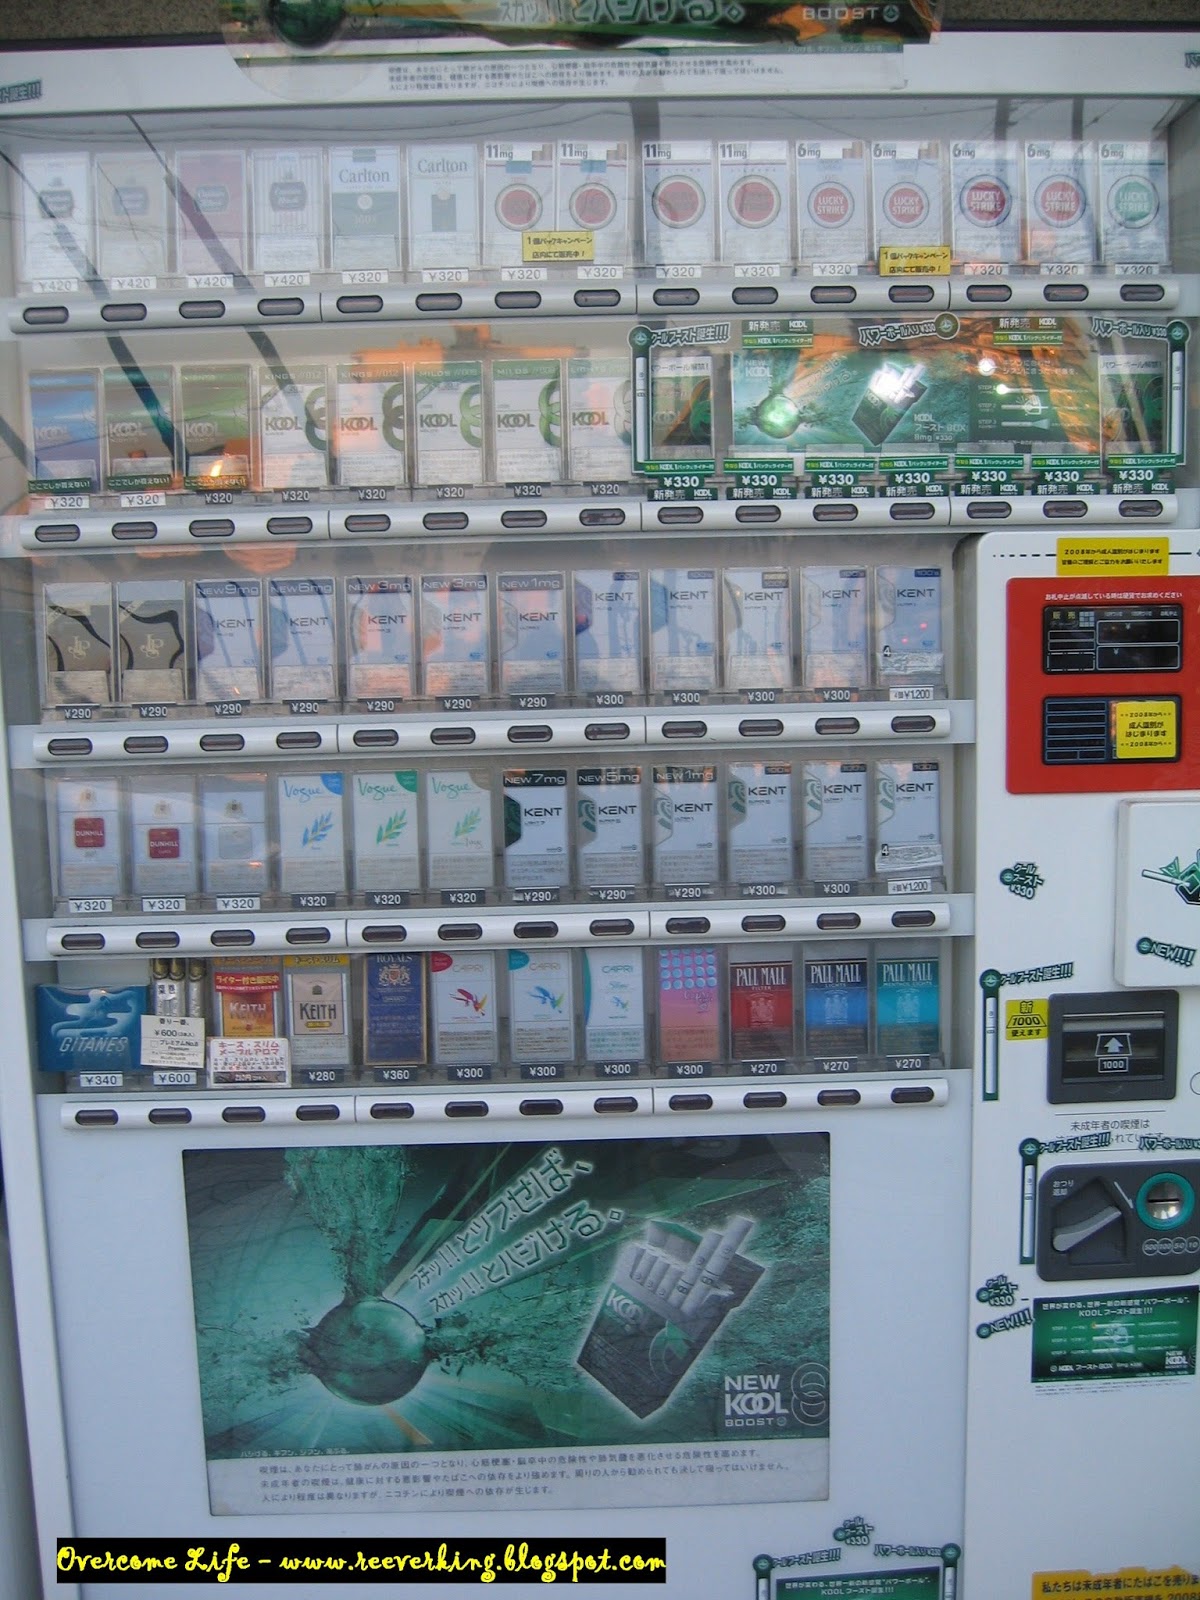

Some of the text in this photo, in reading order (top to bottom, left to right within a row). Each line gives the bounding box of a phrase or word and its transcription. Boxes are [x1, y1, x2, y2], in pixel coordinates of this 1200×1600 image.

[417, 158, 468, 174] Carlton
[339, 168, 390, 184] Carlton
[507, 269, 540, 280] ¥320
[583, 267, 617, 278] ¥320
[663, 266, 695, 277] ¥320
[741, 266, 774, 277] ¥320
[819, 264, 851, 275] ¥320
[970, 265, 1002, 275] ¥320
[1047, 265, 1078, 275] ¥320
[1121, 265, 1152, 274] ¥320
[271, 273, 304, 286] ¥420
[348, 271, 382, 284] ¥320
[429, 271, 463, 281] ¥320
[37, 280, 72, 293] ¥420
[117, 276, 150, 289] ¥420
[194, 275, 227, 288] ¥420
[419, 413, 457, 428] KOOL
[497, 412, 535, 428] KOOL
[572, 411, 609, 426] KOOL
[265, 417, 303, 431] KOOL
[340, 417, 377, 431] KOOL
[35, 427, 68, 440] KOOL
[109, 422, 147, 437] KOOL
[185, 422, 222, 437] KOOL
[742, 474, 777, 486] ¥330
[819, 474, 854, 485] ¥330
[895, 472, 930, 484] ¥330
[972, 471, 1007, 482] ¥330
[1045, 471, 1079, 482] ¥330
[1119, 470, 1153, 481] ¥330
[663, 476, 699, 488] ¥330
[358, 489, 386, 500] ¥320
[436, 487, 464, 498] ¥320
[514, 485, 542, 496] ¥320
[591, 484, 619, 495] ¥320
[126, 494, 159, 505] ¥320
[205, 492, 232, 504] ¥320
[282, 490, 310, 501] ¥320
[50, 496, 83, 507] ¥320
[595, 592, 633, 602] KENT
[670, 591, 708, 600] KENT
[744, 591, 783, 601] KENT
[822, 589, 860, 599] KENT
[897, 589, 935, 599] KENT
[290, 617, 328, 627] KENT
[368, 615, 406, 625] KENT
[443, 613, 481, 622] KENT
[519, 612, 558, 622] KENT
[216, 618, 255, 628] KENT
[596, 695, 624, 705] ¥300
[673, 693, 700, 703] ¥300
[748, 691, 775, 702] ¥300
[823, 690, 850, 700] ¥300
[291, 703, 319, 713] ¥290
[367, 701, 395, 711] ¥290
[444, 699, 472, 710] ¥290
[519, 698, 547, 708] ¥290
[64, 709, 92, 719] ¥290
[140, 707, 168, 717] ¥290
[215, 704, 242, 714] ¥290
[504, 773, 566, 787] NEW 7mg
[283, 780, 323, 803] Vogue
[358, 778, 397, 800] Vogue
[431, 777, 472, 799] Vogue
[748, 786, 787, 795] KENT
[823, 784, 862, 794] KENT
[895, 783, 934, 792] KENT
[523, 807, 562, 817] KENT
[598, 805, 637, 815] KENT
[674, 803, 713, 813] KENT
[674, 888, 701, 897] ¥290
[749, 885, 776, 895] ¥300
[823, 884, 850, 894] ¥300
[374, 895, 401, 904] ¥320
[450, 893, 477, 903] ¥320
[524, 891, 551, 901] ¥290
[599, 890, 627, 900] ¥290
[75, 901, 106, 911] ¥320
[149, 900, 180, 910] ¥320
[222, 899, 254, 909] ¥320
[300, 896, 327, 907] ¥320
[736, 967, 786, 986] PALL MALL
[811, 964, 861, 983] PALL MALL
[883, 963, 932, 982] PALL MALL
[300, 1003, 337, 1020] KEITH
[1013, 1017, 1040, 1026] 1000
[60, 1036, 128, 1052] GITANES
[750, 1063, 777, 1073] ¥270
[823, 1061, 850, 1071] ¥270
[895, 1058, 922, 1069] ¥270
[1102, 1060, 1124, 1069] 1000
[456, 1068, 483, 1078] ¥300
[530, 1066, 556, 1076] ¥300
[604, 1064, 631, 1074] ¥300
[676, 1065, 704, 1075] ¥300
[85, 1075, 117, 1085] ¥340
[159, 1073, 190, 1084] ¥600
[308, 1071, 336, 1081] ¥280
[383, 1070, 410, 1080] ¥360
[725, 1374, 780, 1391] NEW
[725, 1392, 789, 1416] KOOL
[725, 1417, 774, 1427] BOOST
